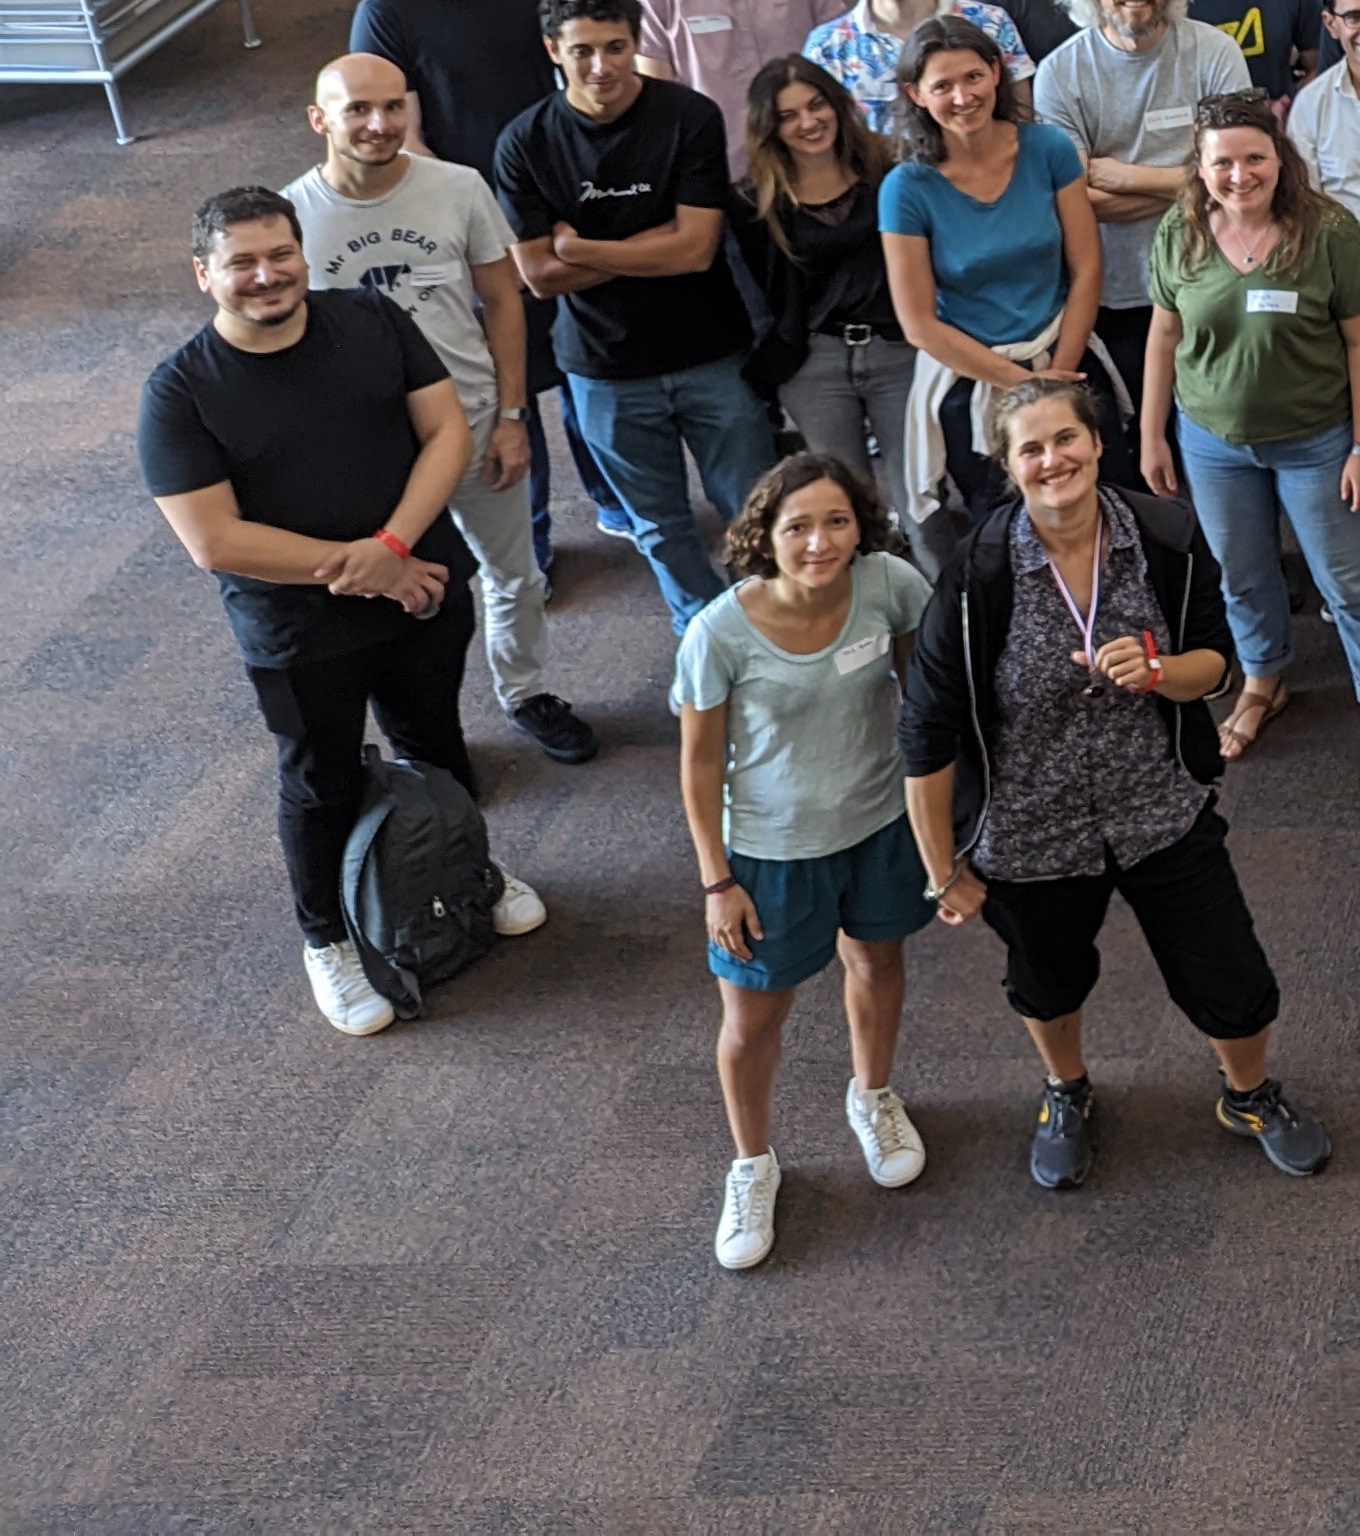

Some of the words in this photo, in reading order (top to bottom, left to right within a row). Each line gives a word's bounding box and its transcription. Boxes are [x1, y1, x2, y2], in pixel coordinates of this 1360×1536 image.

[324, 254, 346, 275] Mr
[347, 231, 382, 253] BIG
[391, 228, 438, 255] BEAR
